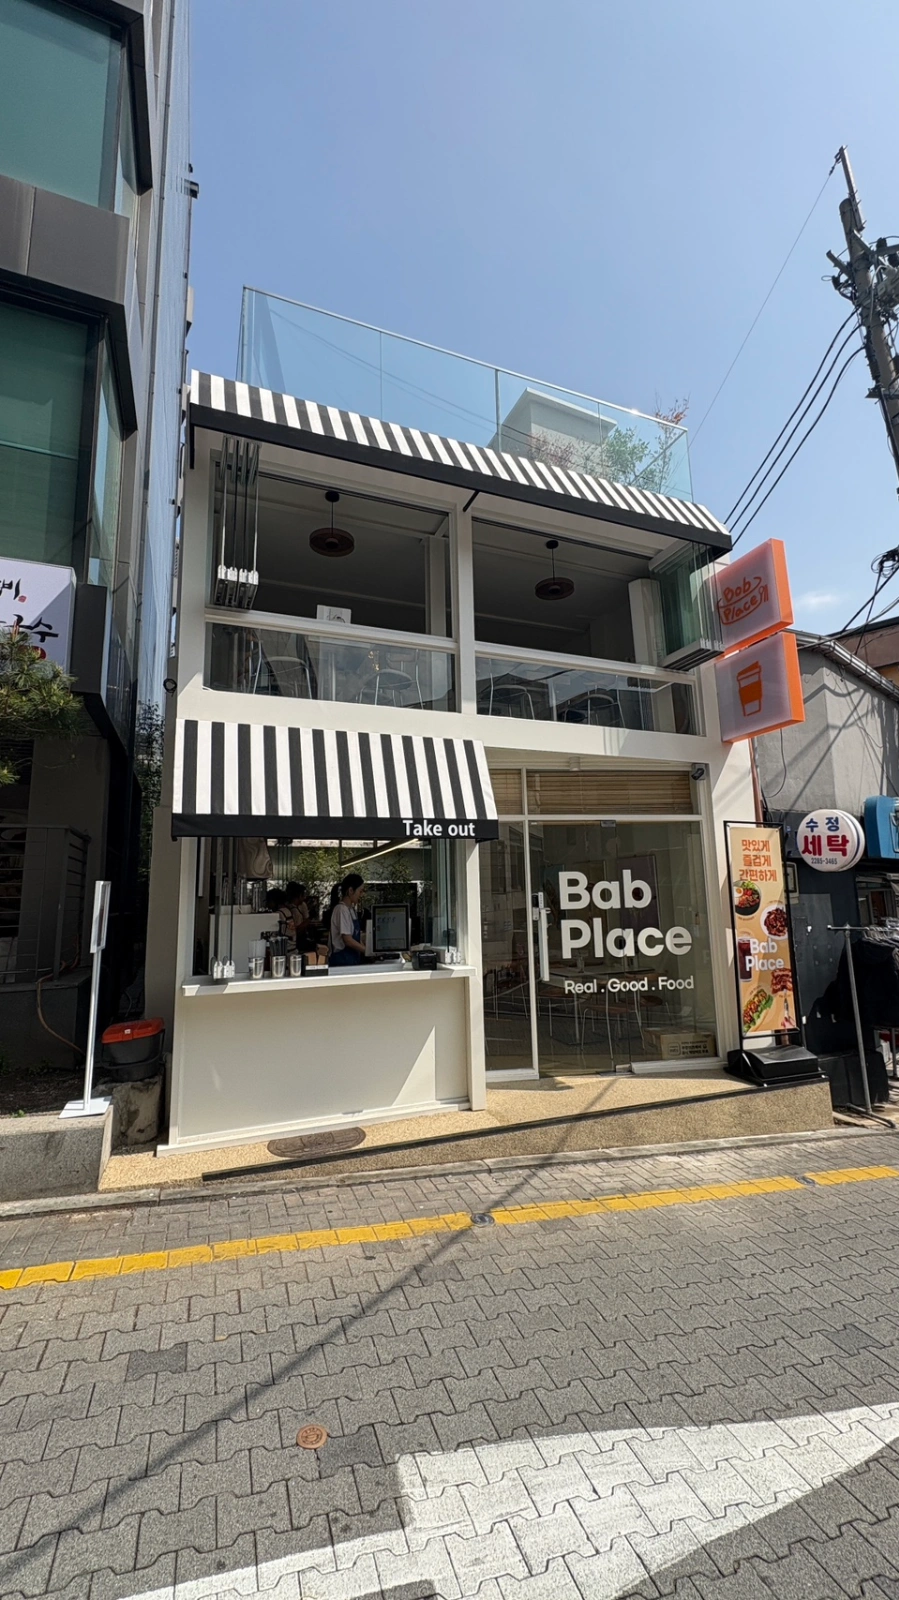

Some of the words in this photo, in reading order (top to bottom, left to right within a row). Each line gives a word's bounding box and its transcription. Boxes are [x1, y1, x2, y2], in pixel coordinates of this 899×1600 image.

[402, 819, 443, 836] Take
[447, 822, 476, 836] out
[741, 839, 771, 852] 맛있게
[801, 834, 850, 857] 세탁
[743, 854, 772, 867] 즐겁게
[739, 869, 778, 882] 간편하게
[559, 869, 652, 910] Bab
[561, 917, 692, 959] Place
[750, 938, 778, 954] Bab
[745, 955, 785, 972] Place
[564, 979, 598, 994] Real
[608, 977, 648, 993] Good
[658, 975, 694, 991] Food
